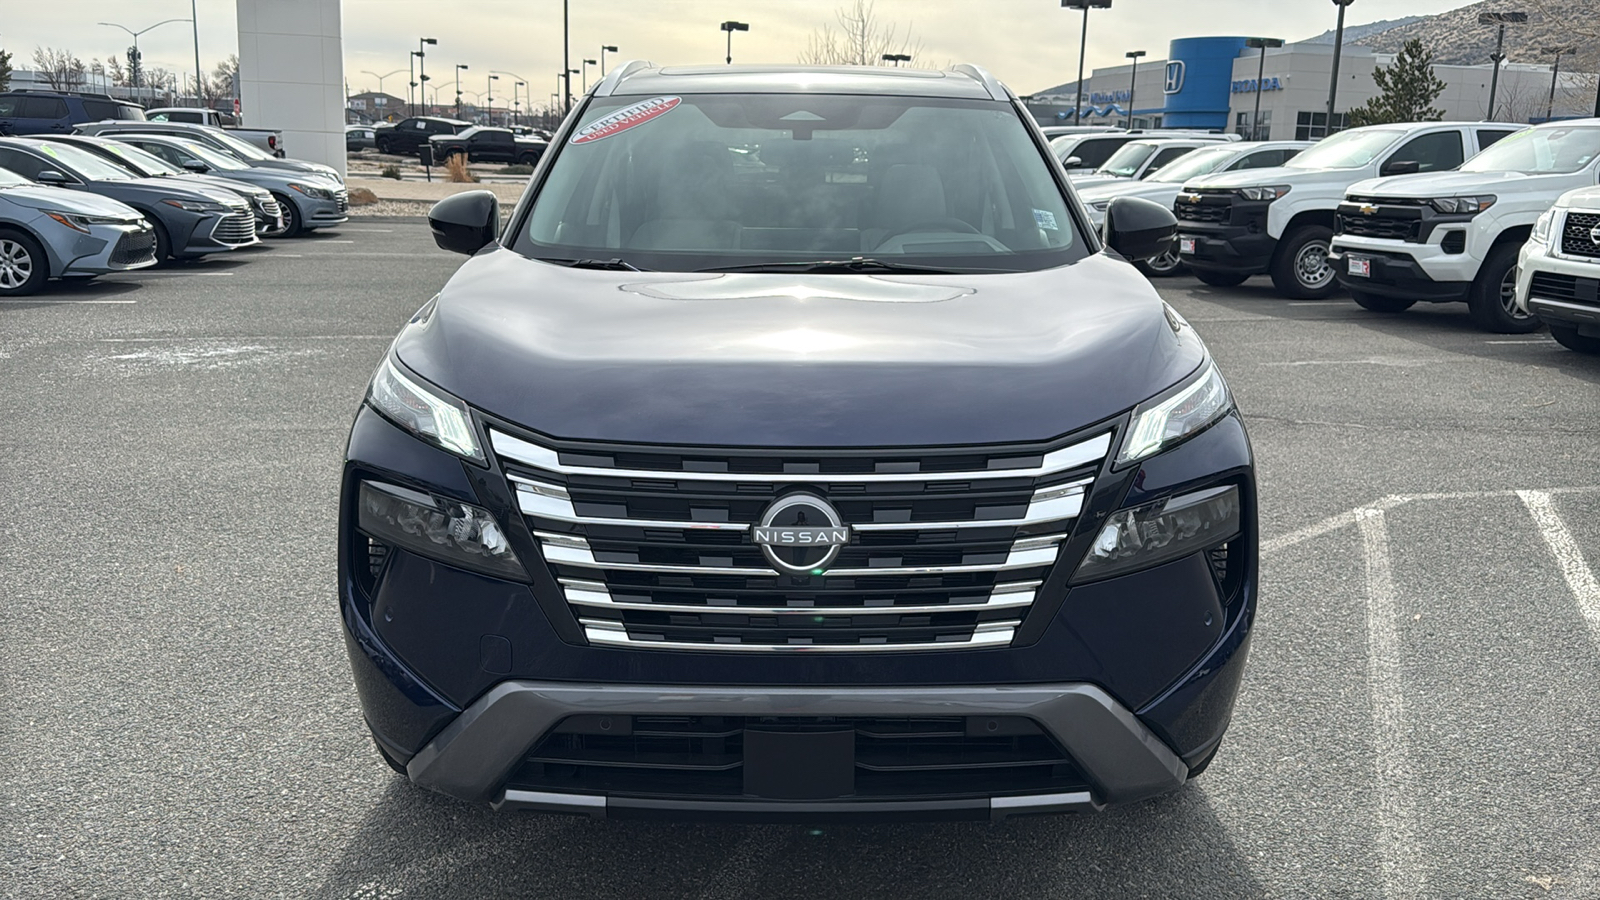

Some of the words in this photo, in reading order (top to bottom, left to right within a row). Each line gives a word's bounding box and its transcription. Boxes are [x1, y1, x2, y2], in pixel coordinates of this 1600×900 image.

[1232, 77, 1282, 93] HONDA
[580, 98, 665, 136] CERTIFIED
[586, 123, 619, 140] USED
[620, 102, 673, 125] VEHICLE
[756, 530, 846, 543] NISSAN
